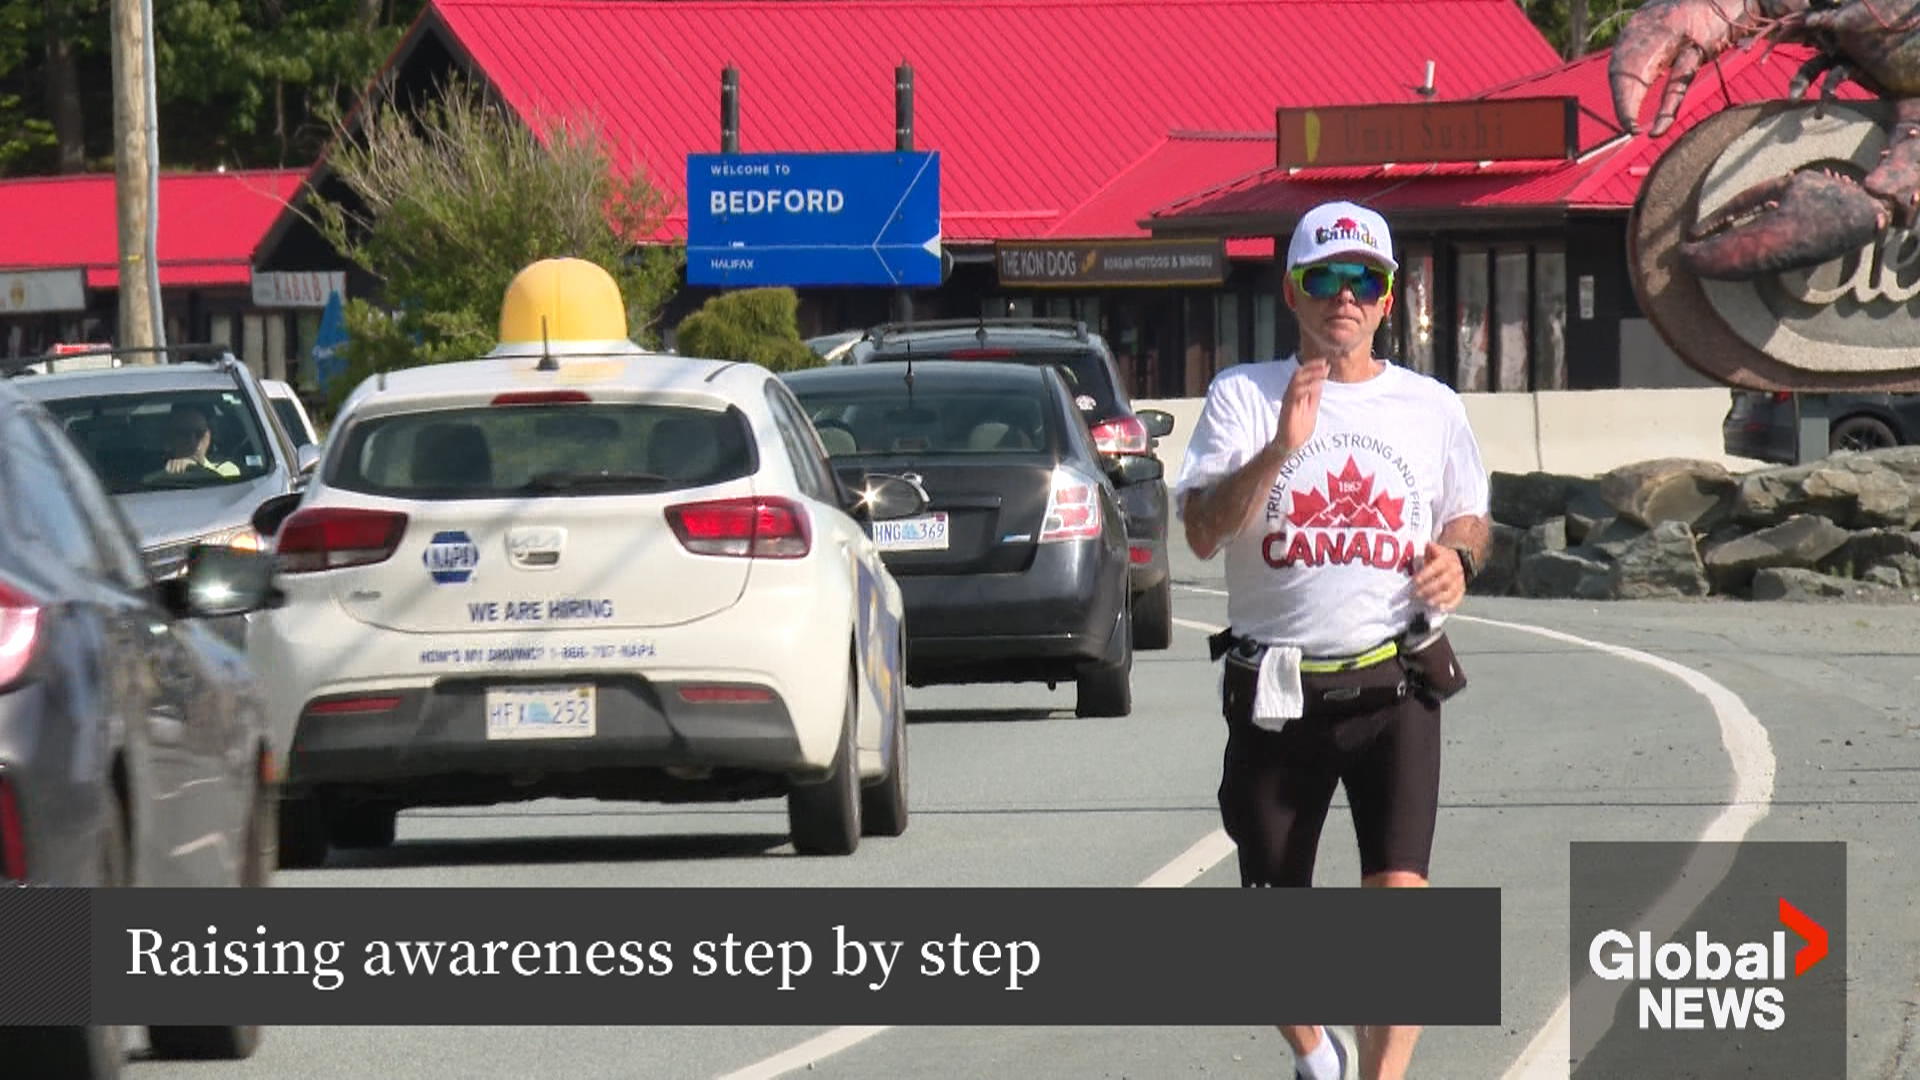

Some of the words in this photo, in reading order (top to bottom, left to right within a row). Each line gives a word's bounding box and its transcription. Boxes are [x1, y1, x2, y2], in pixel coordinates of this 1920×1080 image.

[1420, 107, 1505, 151] Sushi
[710, 164, 770, 176] WELCOME
[775, 164, 791, 175] TO
[710, 189, 844, 214] BEDFORD
[710, 259, 754, 269] HALIFAX
[1001, 250, 1020, 275] THE
[1021, 250, 1044, 275] KON
[1046, 250, 1077, 276] DOG
[1266, 482, 1286, 522] TRUE
[1332, 433, 1393, 460] STRONG
[1392, 457, 1415, 488] AND
[1409, 490, 1422, 530] FREE
[874, 524, 901, 542] HNG
[919, 523, 945, 540] 369
[1262, 531, 1415, 577] CANADA
[468, 602, 499, 622] WE
[505, 601, 542, 621] ARE
[548, 599, 614, 619] HIRING
[551, 701, 589, 724] 252
